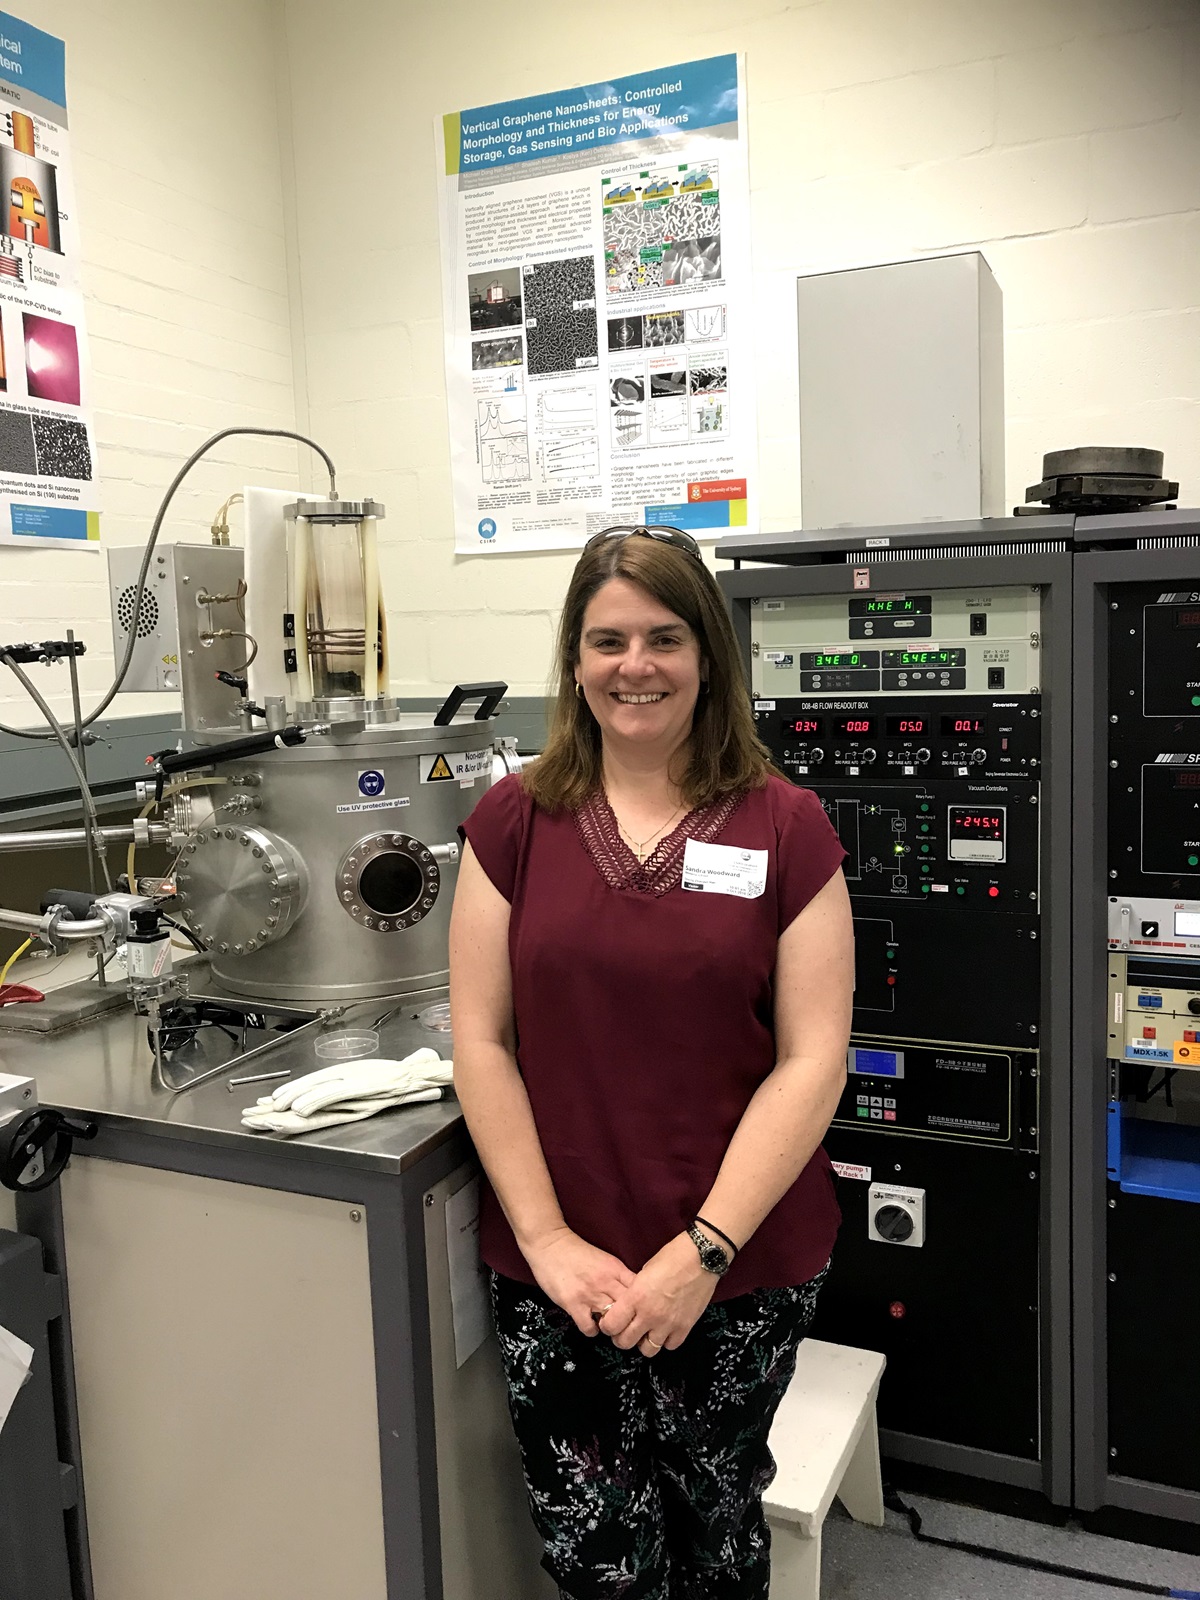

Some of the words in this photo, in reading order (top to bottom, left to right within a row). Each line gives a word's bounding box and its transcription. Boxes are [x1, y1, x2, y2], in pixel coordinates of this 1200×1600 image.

[462, 118, 500, 135] Vertical
[502, 110, 552, 127] Graphene
[556, 95, 622, 117] Nanosheets:
[625, 80, 682, 102] Controlled
[464, 131, 522, 149] Morphology
[526, 126, 544, 138] and
[548, 114, 600, 133] Thickness
[604, 112, 619, 122] for
[622, 103, 661, 118] Energy
[464, 150, 505, 164] Storage,
[508, 145, 528, 156] Gas
[531, 137, 572, 152] Sensing
[576, 129, 594, 142] and
[598, 126, 616, 138] Bio
[620, 113, 688, 135] Applications
[601, 167, 620, 175] Control
[629, 160, 656, 170] Thickness
[14, 182, 38, 195] PLASMA
[464, 190, 494, 200] Introduction
[502, 198, 522, 206] graphene
[524, 194, 547, 202] nanosheet
[526, 247, 566, 258] Plasma-assisted
[568, 244, 593, 252] synthesis
[34, 266, 42, 274] DC
[43, 268, 54, 277] bias
[13, 281, 28, 291] pump
[34, 276, 58, 286] substrate
[24, 299, 46, 312] ICP-CVD
[48, 306, 62, 316] setup
[607, 307, 632, 316] Industrial
[636, 304, 666, 313] applications
[51, 410, 78, 420] magnetron
[0, 480, 23, 488] quantum
[55, 486, 80, 494] nanocones
[44, 492, 56, 500] (100)
[456, 765, 464, 773] IR
[465, 764, 476, 772] &/or
[362, 800, 393, 811] protective
[394, 798, 410, 808] glass
[685, 866, 706, 874] Sandra
[707, 868, 741, 878] Woodward
[1134, 1049, 1169, 1057] MDX-1.5K
